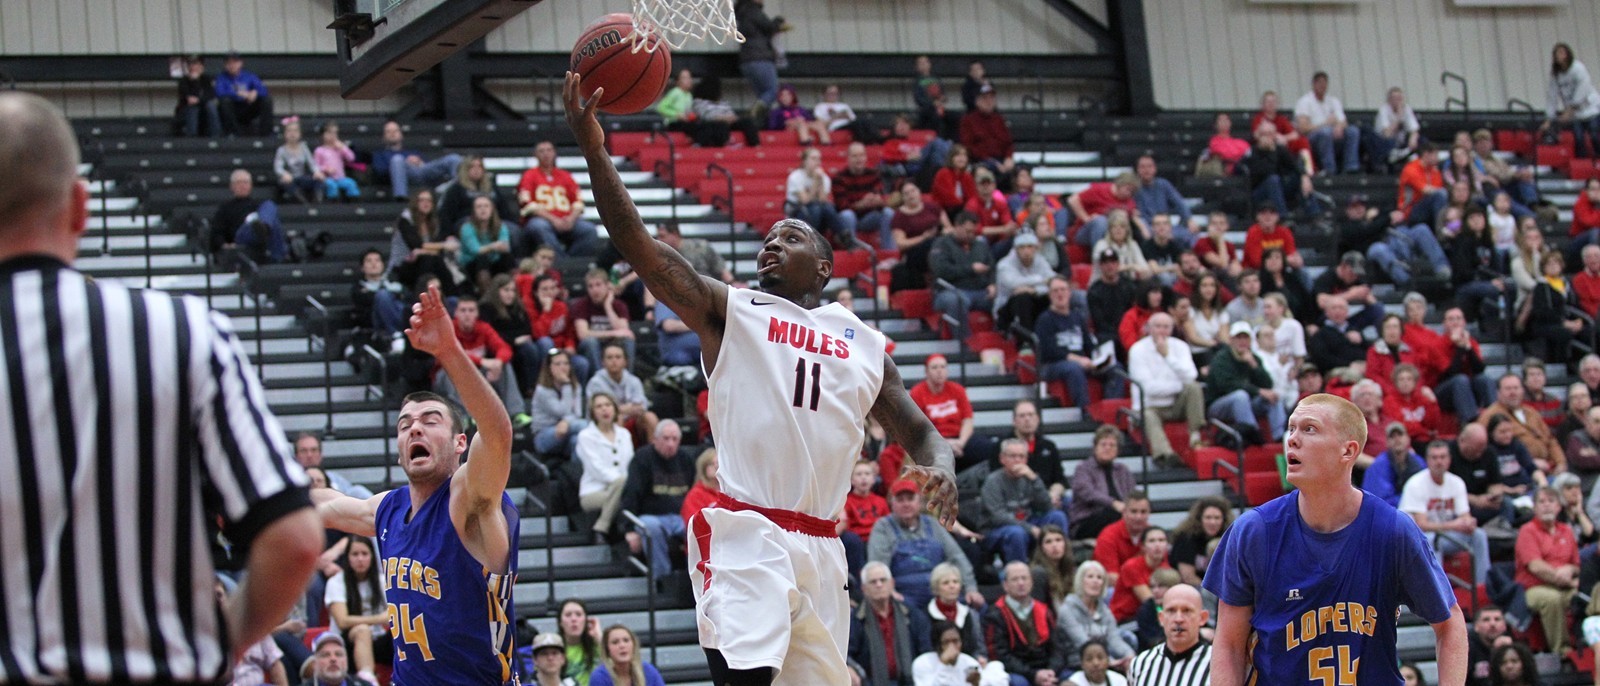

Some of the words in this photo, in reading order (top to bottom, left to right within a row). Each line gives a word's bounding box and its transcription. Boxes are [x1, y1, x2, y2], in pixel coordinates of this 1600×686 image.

[535, 184, 571, 211] 56
[767, 316, 850, 360] MULES
[793, 356, 821, 412] 11
[382, 557, 441, 600] PERS
[1285, 601, 1378, 652] LOPERS
[1308, 645, 1360, 686] 54
